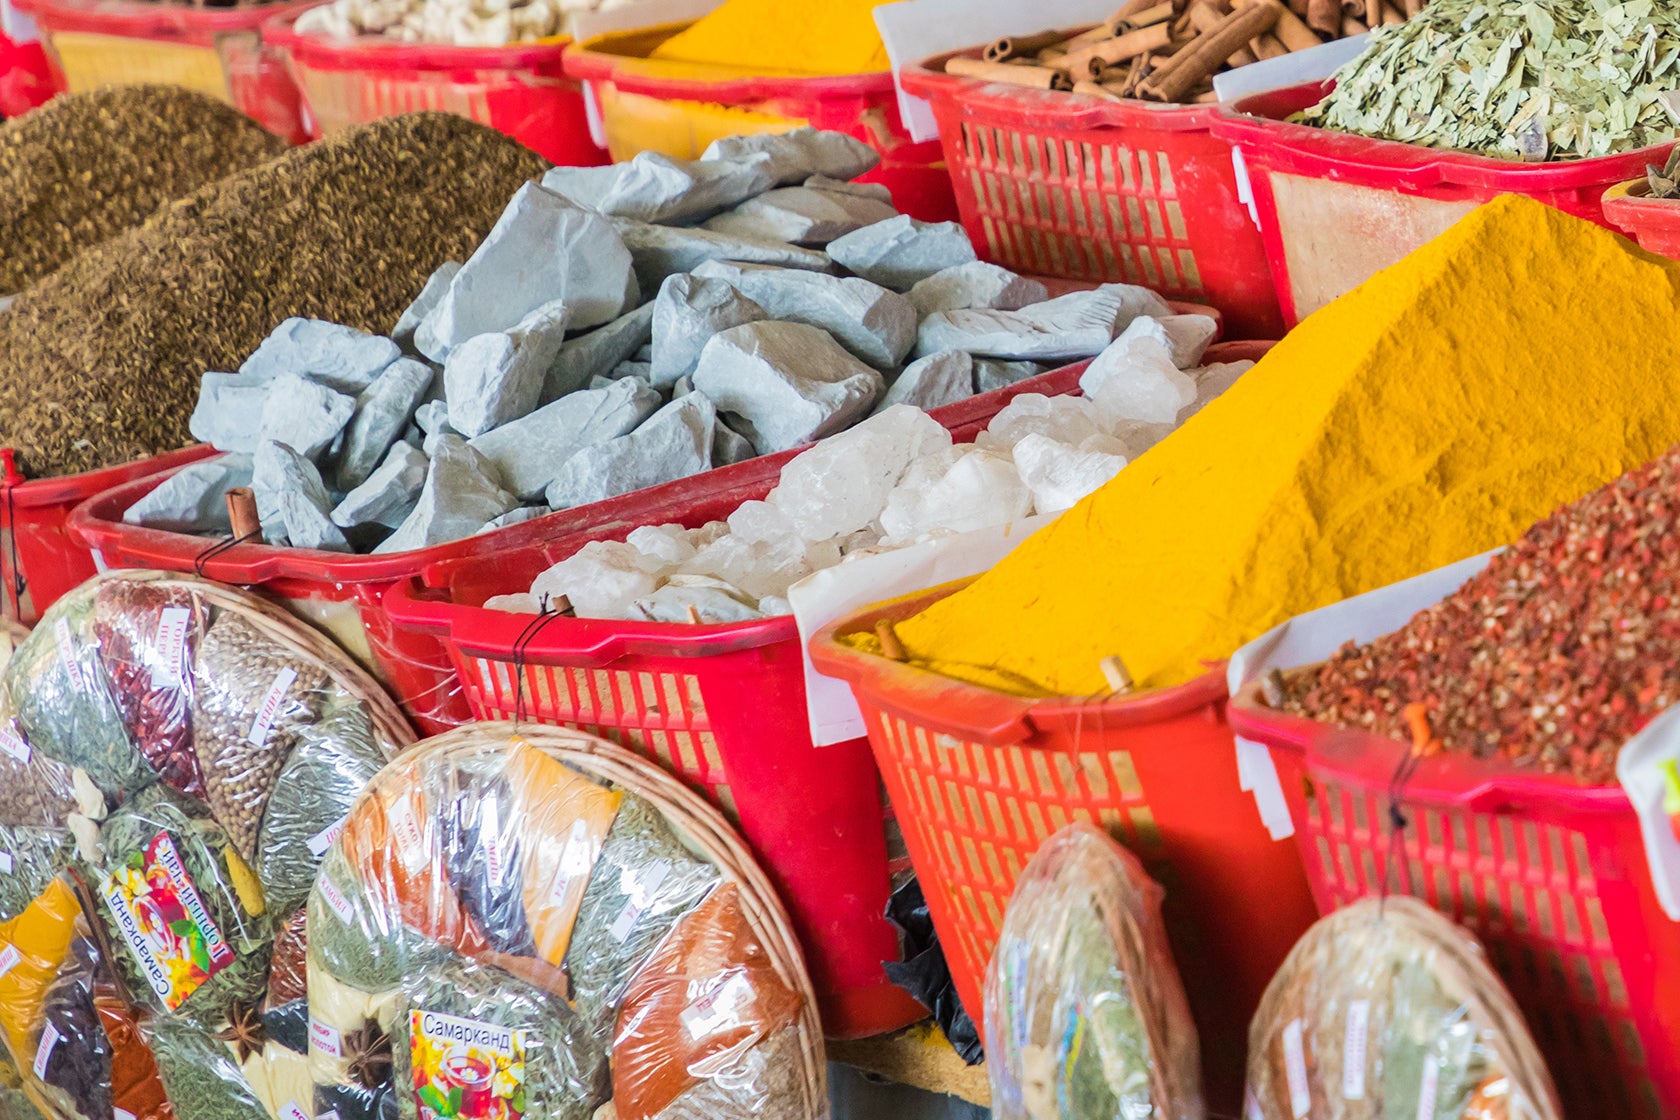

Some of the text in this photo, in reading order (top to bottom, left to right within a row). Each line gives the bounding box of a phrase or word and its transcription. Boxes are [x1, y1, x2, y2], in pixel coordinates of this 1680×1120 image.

[259, 687, 282, 730] КИНЗА
[110, 891, 170, 996] Самарканд
[179, 887, 228, 963] Горный
[424, 1014, 510, 1052] Самарканд
